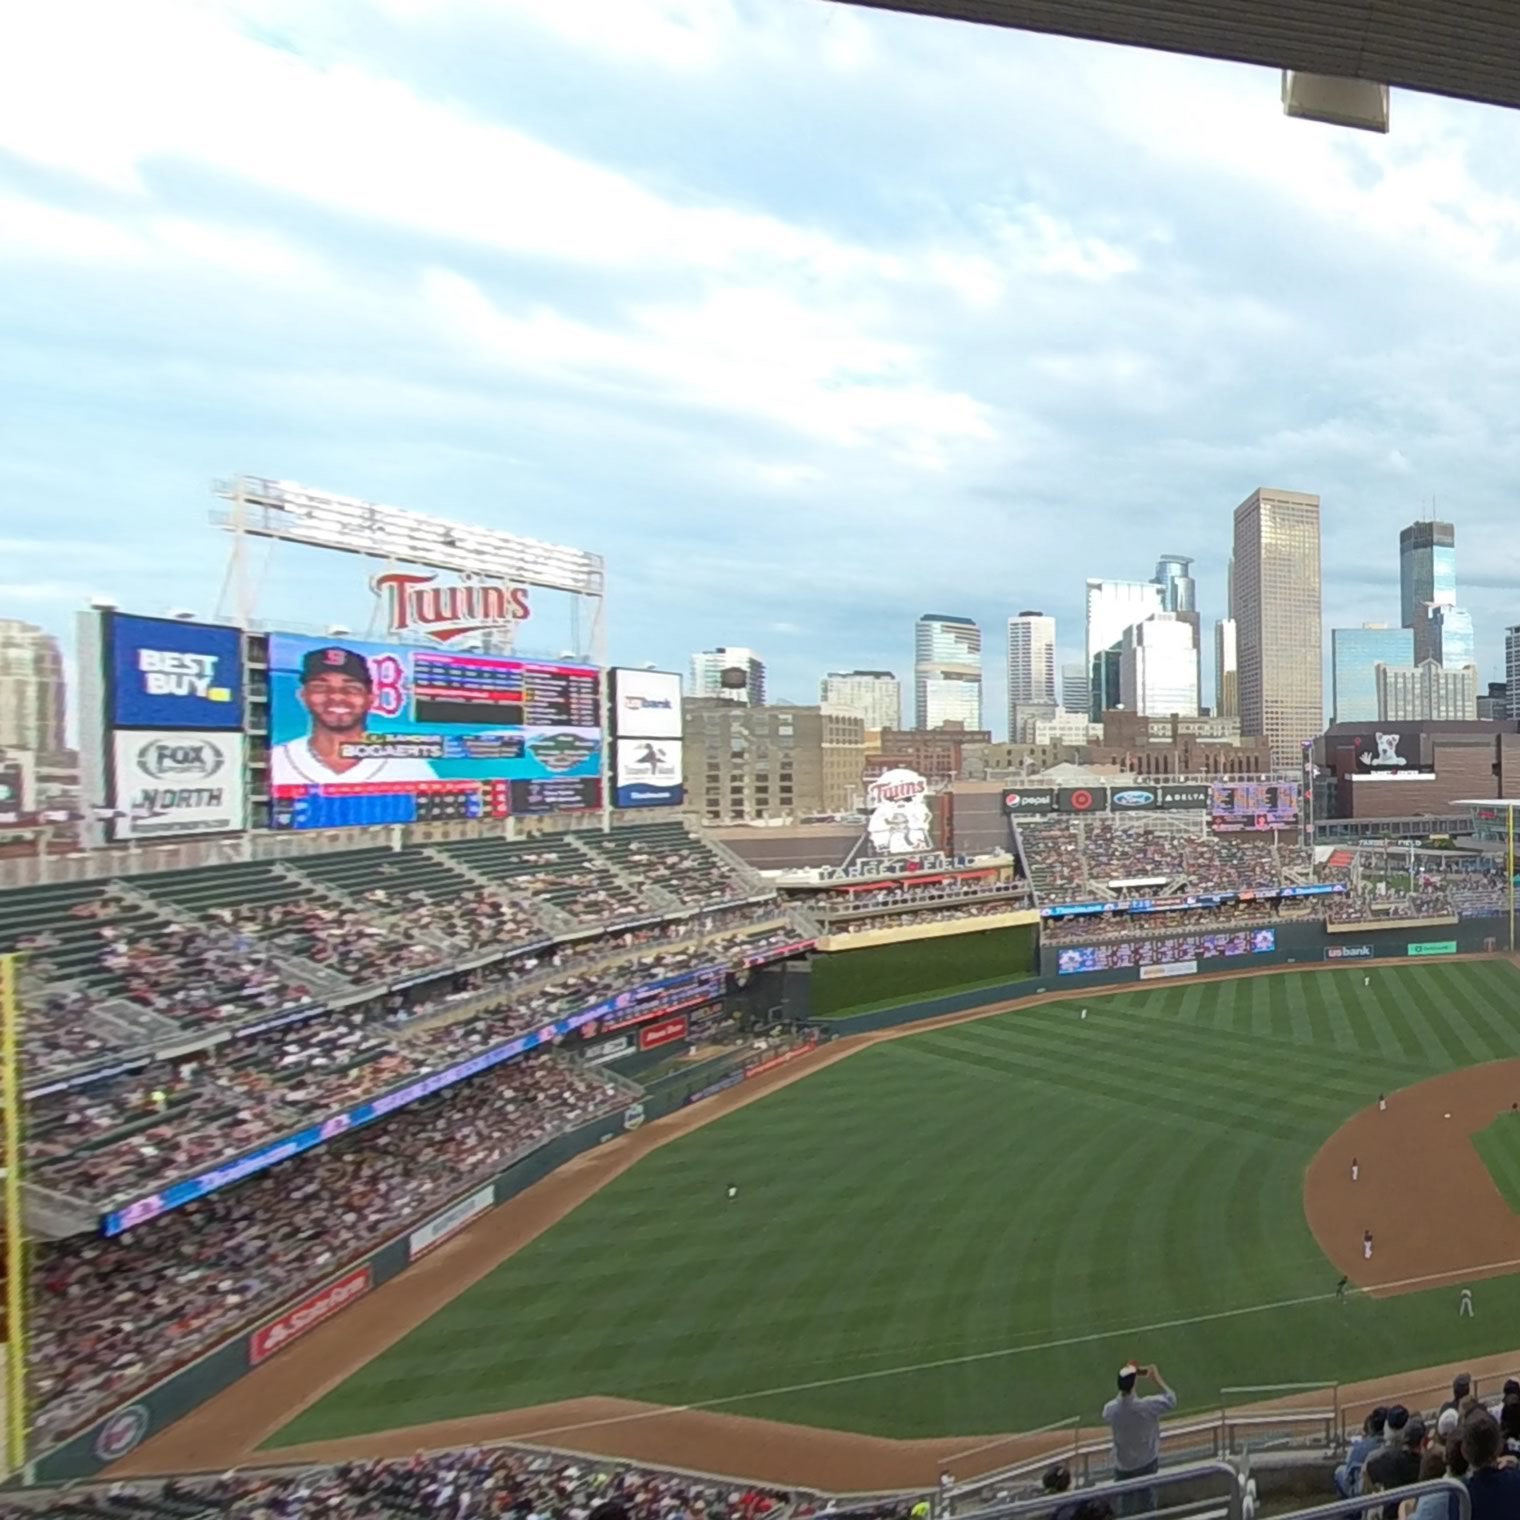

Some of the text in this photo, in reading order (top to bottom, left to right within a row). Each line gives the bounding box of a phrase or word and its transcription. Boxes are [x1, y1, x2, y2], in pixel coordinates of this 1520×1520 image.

[376, 572, 531, 630] Twins
[137, 648, 219, 676] BEST
[145, 673, 213, 697] BUY
[155, 744, 206, 765] FOX
[139, 786, 224, 811] NORTH
[869, 780, 926, 803] Twins
[1021, 795, 1051, 806] pepsi
[1174, 793, 1206, 801] DELTA
[818, 857, 976, 881] TARGET FIELD
